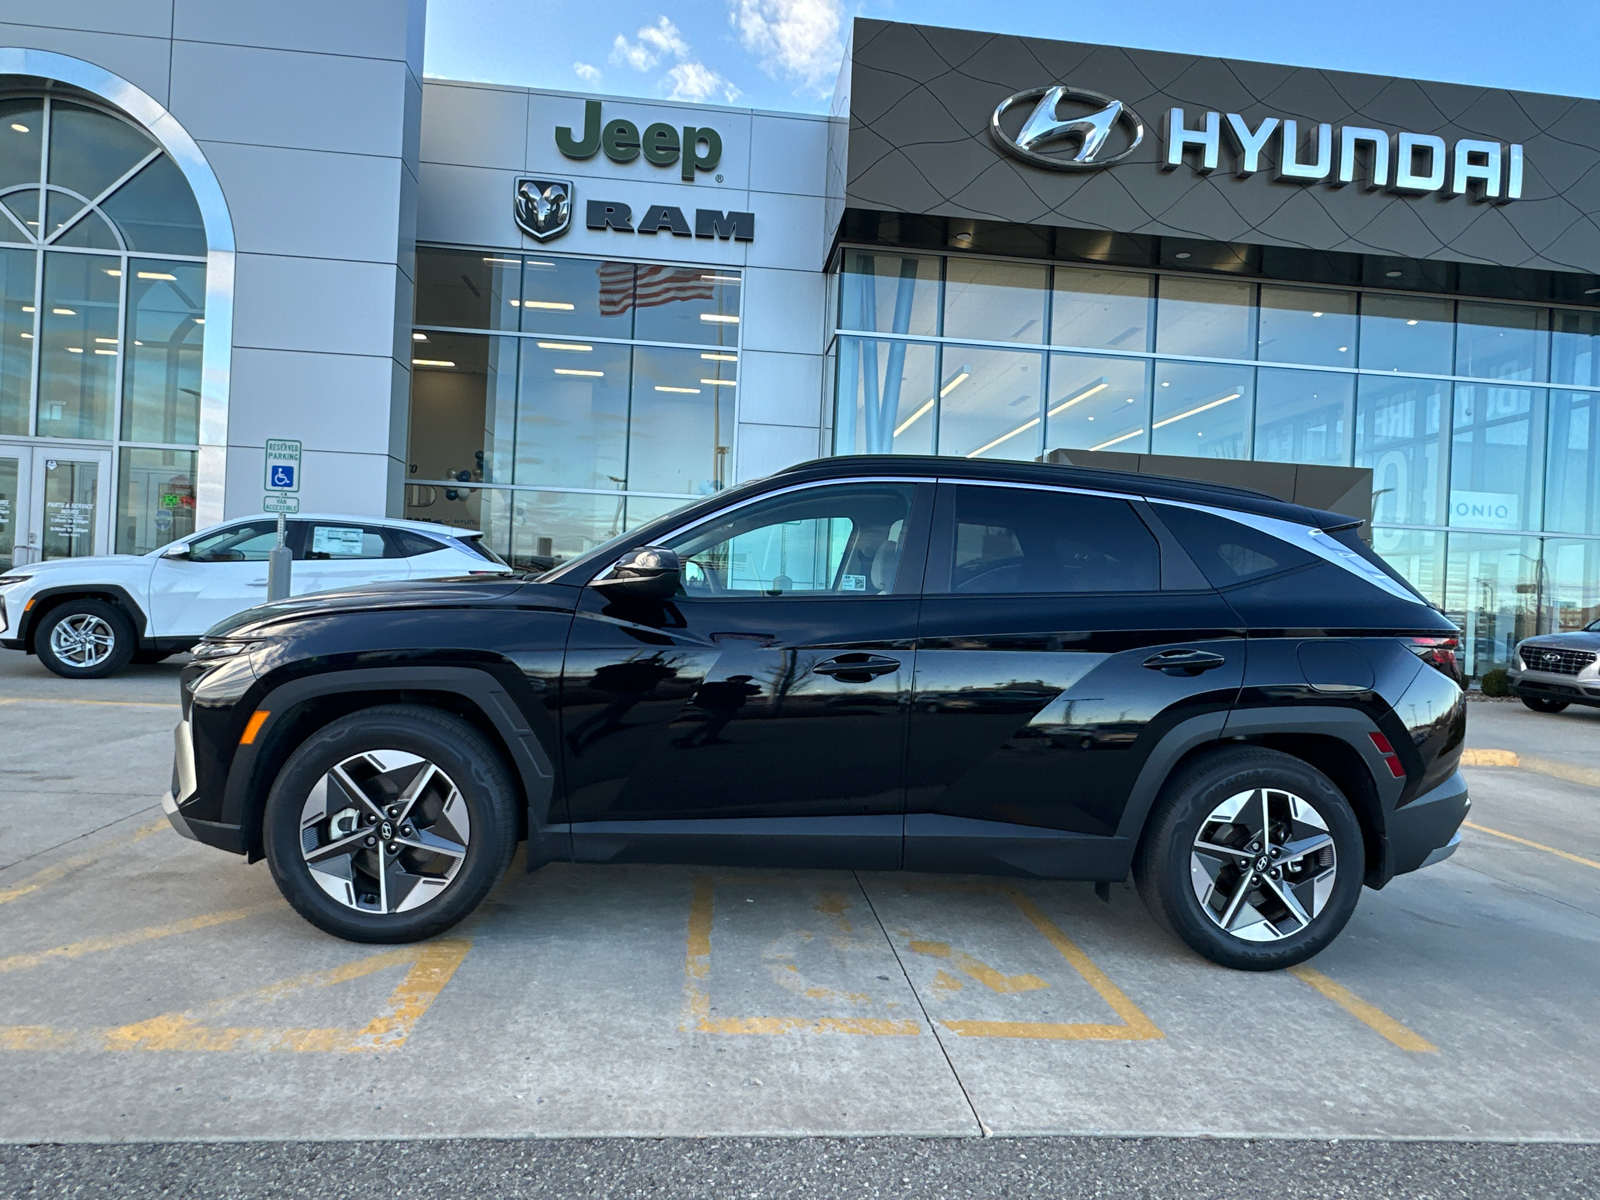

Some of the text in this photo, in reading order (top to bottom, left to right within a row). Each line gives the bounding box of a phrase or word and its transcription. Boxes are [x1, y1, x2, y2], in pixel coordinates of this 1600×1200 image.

[555, 100, 722, 181] Jeep
[1163, 107, 1523, 199] HYUNDAI
[586, 199, 755, 242] RAM
[268, 452, 298, 461] PARKING
[269, 443, 298, 452] RESERVED
[71, 502, 94, 510] SERVICE
